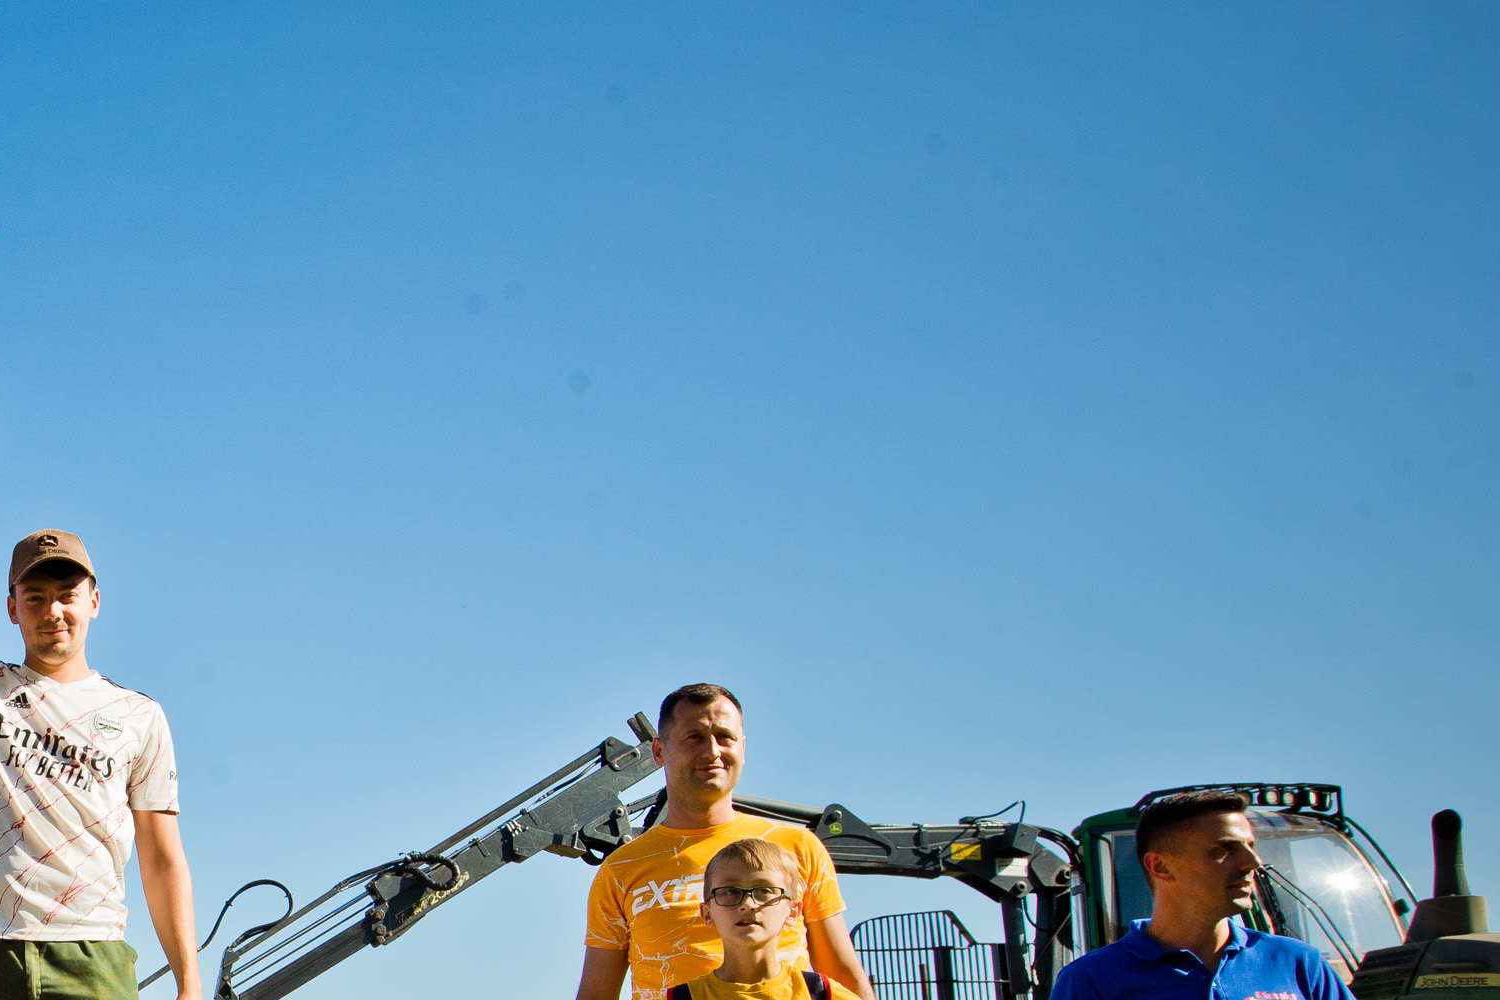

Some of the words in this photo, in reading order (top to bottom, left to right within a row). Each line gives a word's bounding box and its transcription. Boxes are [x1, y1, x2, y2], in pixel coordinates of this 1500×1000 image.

[6, 744, 34, 768] FLY
[35, 756, 94, 792] BETTER
[1420, 978, 1449, 987] JOHN
[1450, 976, 1488, 986] DEERE
